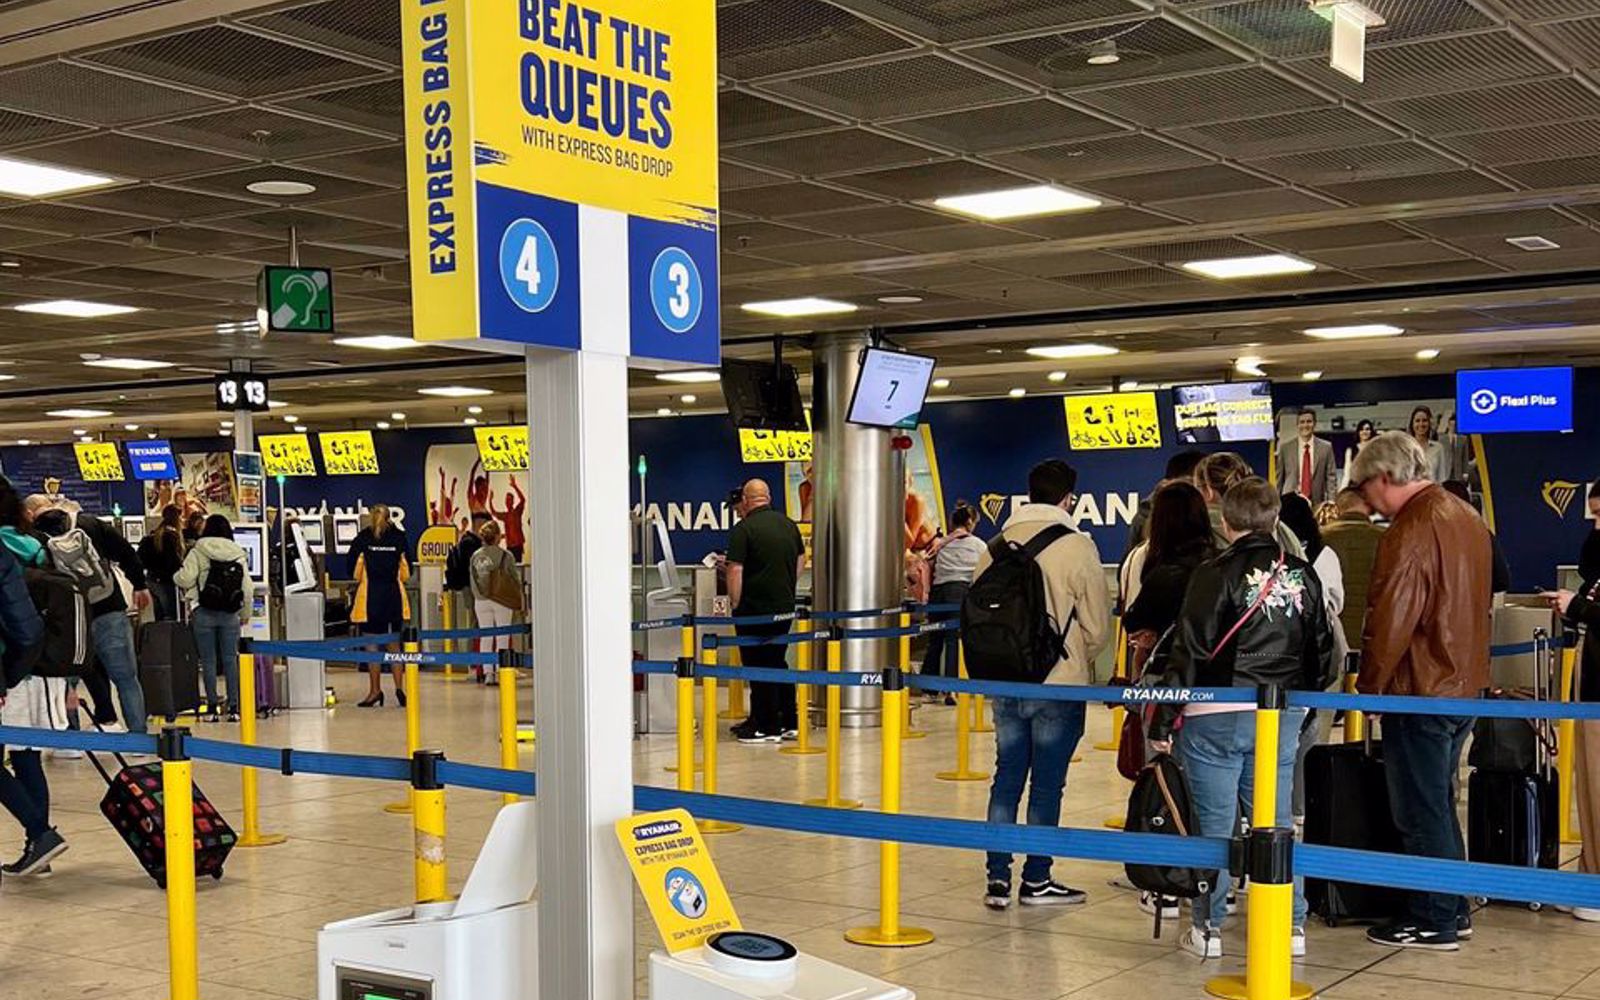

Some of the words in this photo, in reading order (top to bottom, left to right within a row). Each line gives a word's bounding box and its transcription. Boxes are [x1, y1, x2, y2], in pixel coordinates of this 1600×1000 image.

[420, 12, 449, 93] BAG
[519, 0, 602, 60] BEAT
[609, 16, 671, 82] THE
[519, 52, 673, 150] QUEUES
[521, 124, 555, 151] WITH
[557, 134, 612, 165] EXPRESS
[615, 148, 640, 171] BAG
[641, 157, 673, 178] DROP
[423, 100, 456, 274] EXPRESS
[515, 235, 541, 295] 4
[668, 262, 690, 319] 3
[313, 310, 328, 328] T
[218, 380, 238, 404] 13
[243, 381, 265, 405] 13
[887, 380, 899, 402] 7
[1531, 395, 1557, 406] Plus
[1122, 688, 1214, 701] RYANAIR.COM
[635, 842, 664, 856] EXPRESS
[664, 839, 677, 850] BAG
[640, 822, 680, 836] RYANAIR
